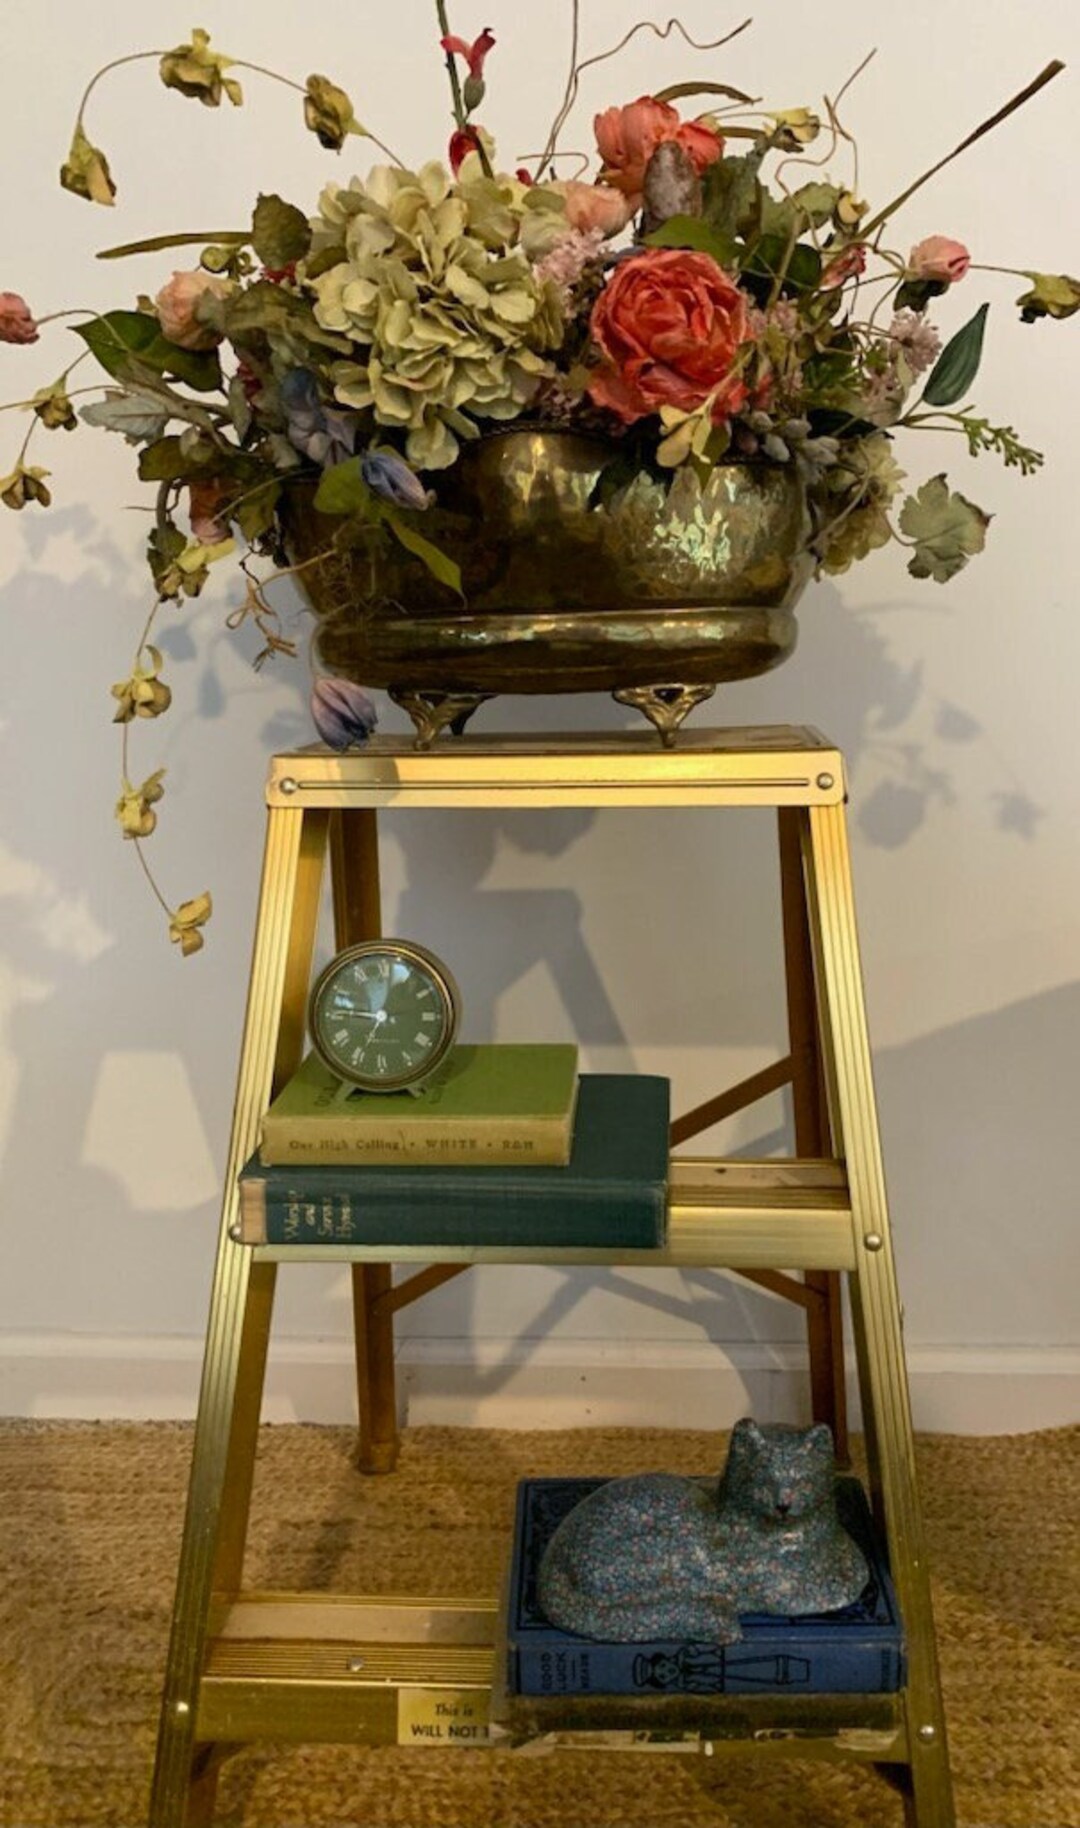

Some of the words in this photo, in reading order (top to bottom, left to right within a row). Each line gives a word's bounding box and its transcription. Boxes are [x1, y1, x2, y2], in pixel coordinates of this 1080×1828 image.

[319, 1139, 349, 1152] High
[356, 1138, 400, 1152] Calling
[426, 1139, 477, 1150] WHITE
[541, 1651, 553, 1691] GOOD
[555, 1651, 567, 1691] LUCK
[435, 1703, 458, 1716] This
[462, 1703, 473, 1716] is
[410, 1723, 443, 1738] WILL
[448, 1725, 479, 1738] NOT
